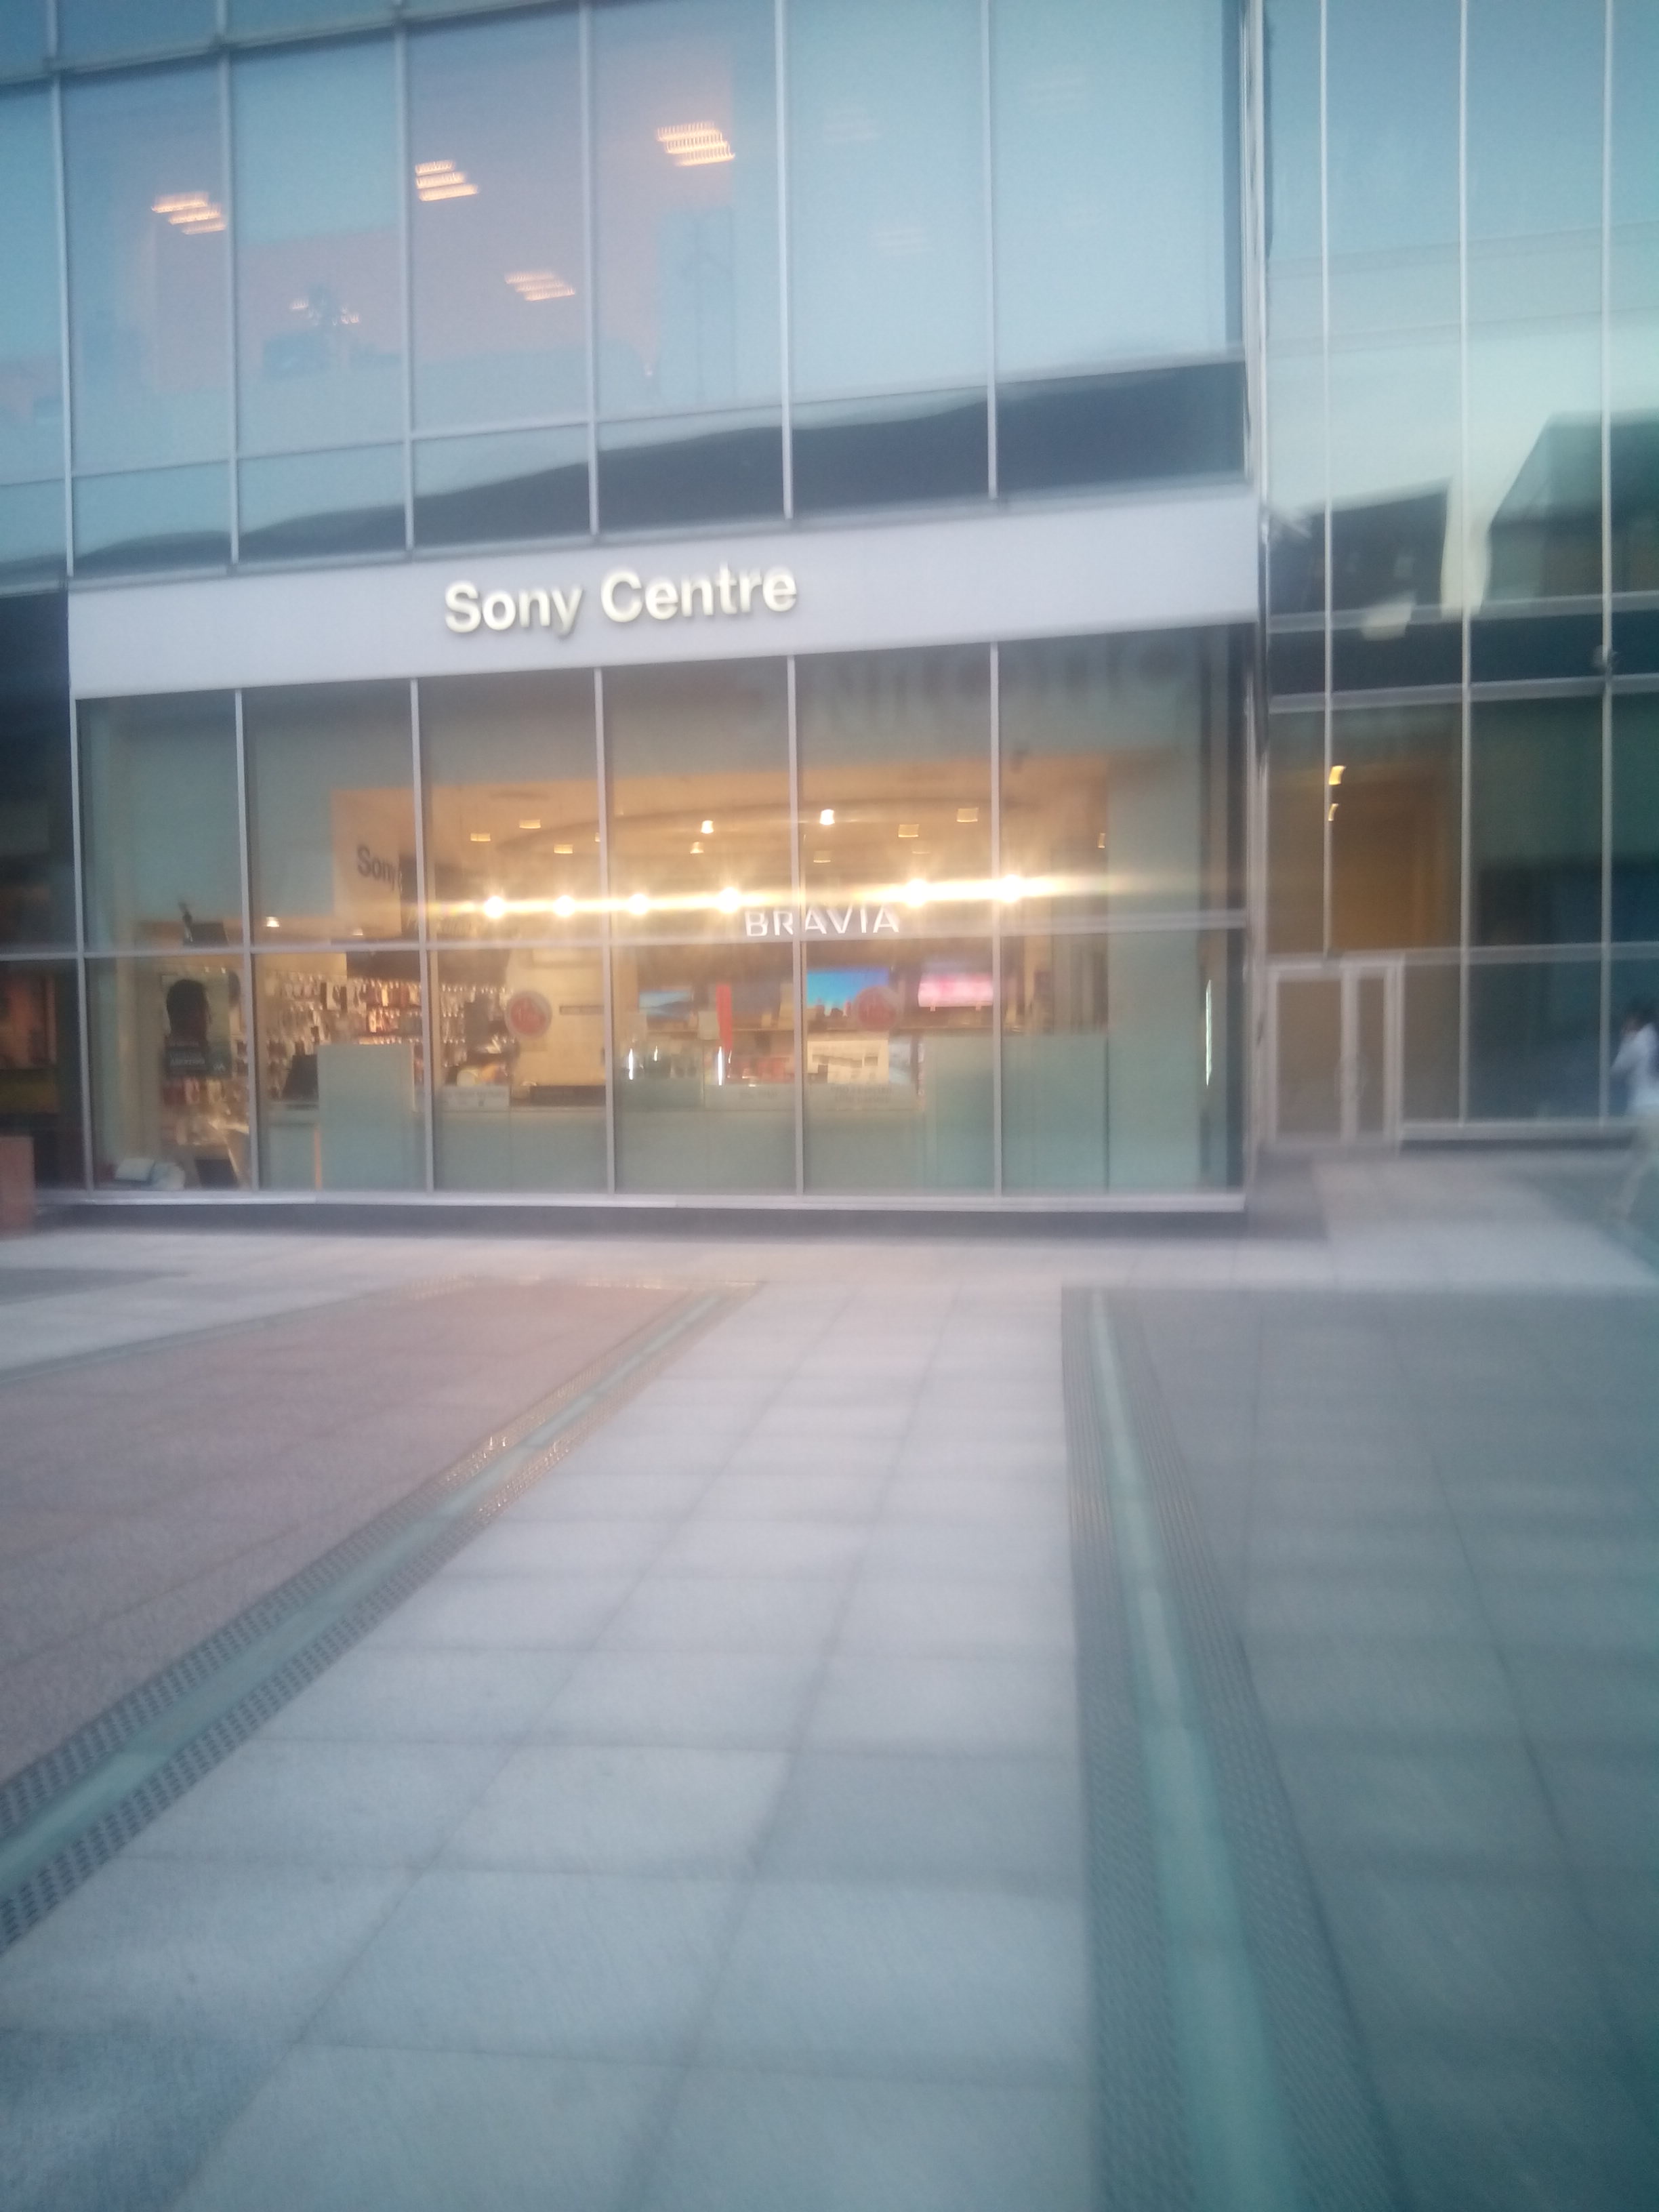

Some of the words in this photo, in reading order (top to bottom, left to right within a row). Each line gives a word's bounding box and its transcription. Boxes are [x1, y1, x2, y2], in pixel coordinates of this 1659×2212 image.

[444, 579, 583, 637] Sony
[600, 561, 798, 623] Centre
[356, 844, 398, 892] Sony
[745, 904, 900, 937] BRAVIA
